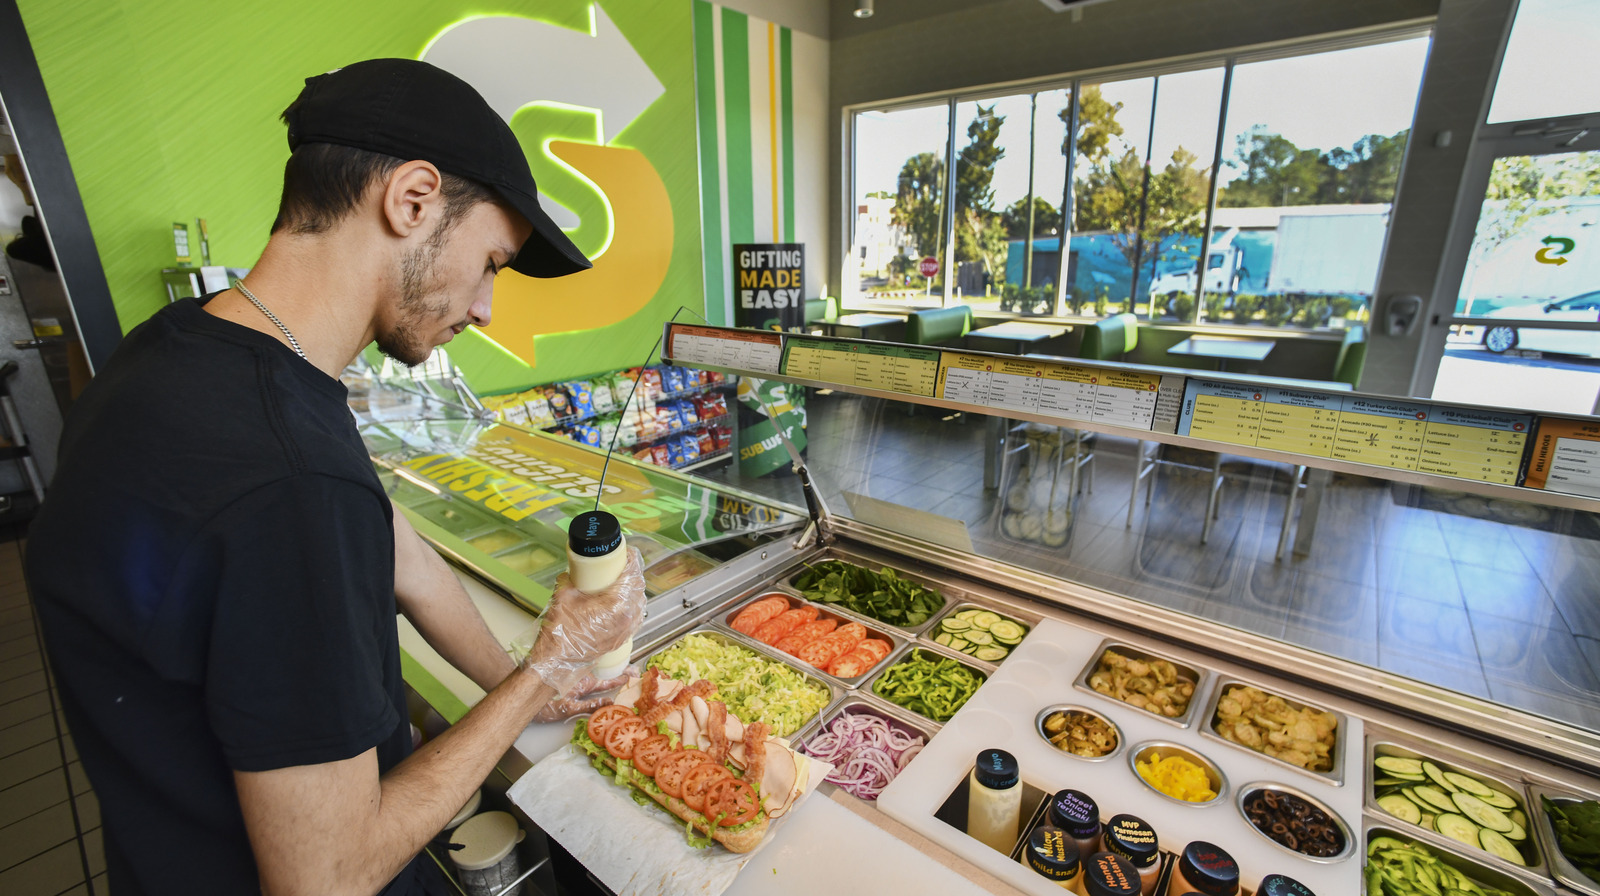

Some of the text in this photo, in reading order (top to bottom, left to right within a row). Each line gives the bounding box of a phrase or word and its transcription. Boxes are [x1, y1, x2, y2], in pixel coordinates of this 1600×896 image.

[740, 250, 801, 268] GIFTING
[920, 262, 938, 272] STOP
[741, 270, 801, 288] MADE
[741, 289, 801, 309] EASY
[1367, 402, 1385, 410] Turkey
[1456, 412, 1492, 421] Pickleball
[1487, 447, 1518, 455] End-to-end
[1536, 434, 1550, 472] DELI HEROES
[402, 452, 569, 522] FRESHLY
[587, 516, 600, 537] Mayo
[584, 534, 622, 553] richly cre
[992, 753, 1003, 770] Mayo
[1064, 799, 1089, 815] Onion
[1066, 793, 1093, 810] Sweet
[1057, 801, 1090, 822] Teriyaki
[1113, 826, 1153, 836] Parmesan
[1121, 820, 1140, 829] MVP
[1043, 832, 1054, 857] Yellow
[1053, 830, 1066, 862] Mustard
[1115, 832, 1155, 844] Vinaigrette
[1146, 853, 1158, 862] sav
[1033, 860, 1053, 874] mild
[1097, 860, 1118, 887] Honey
[1105, 855, 1131, 890] Mustard
